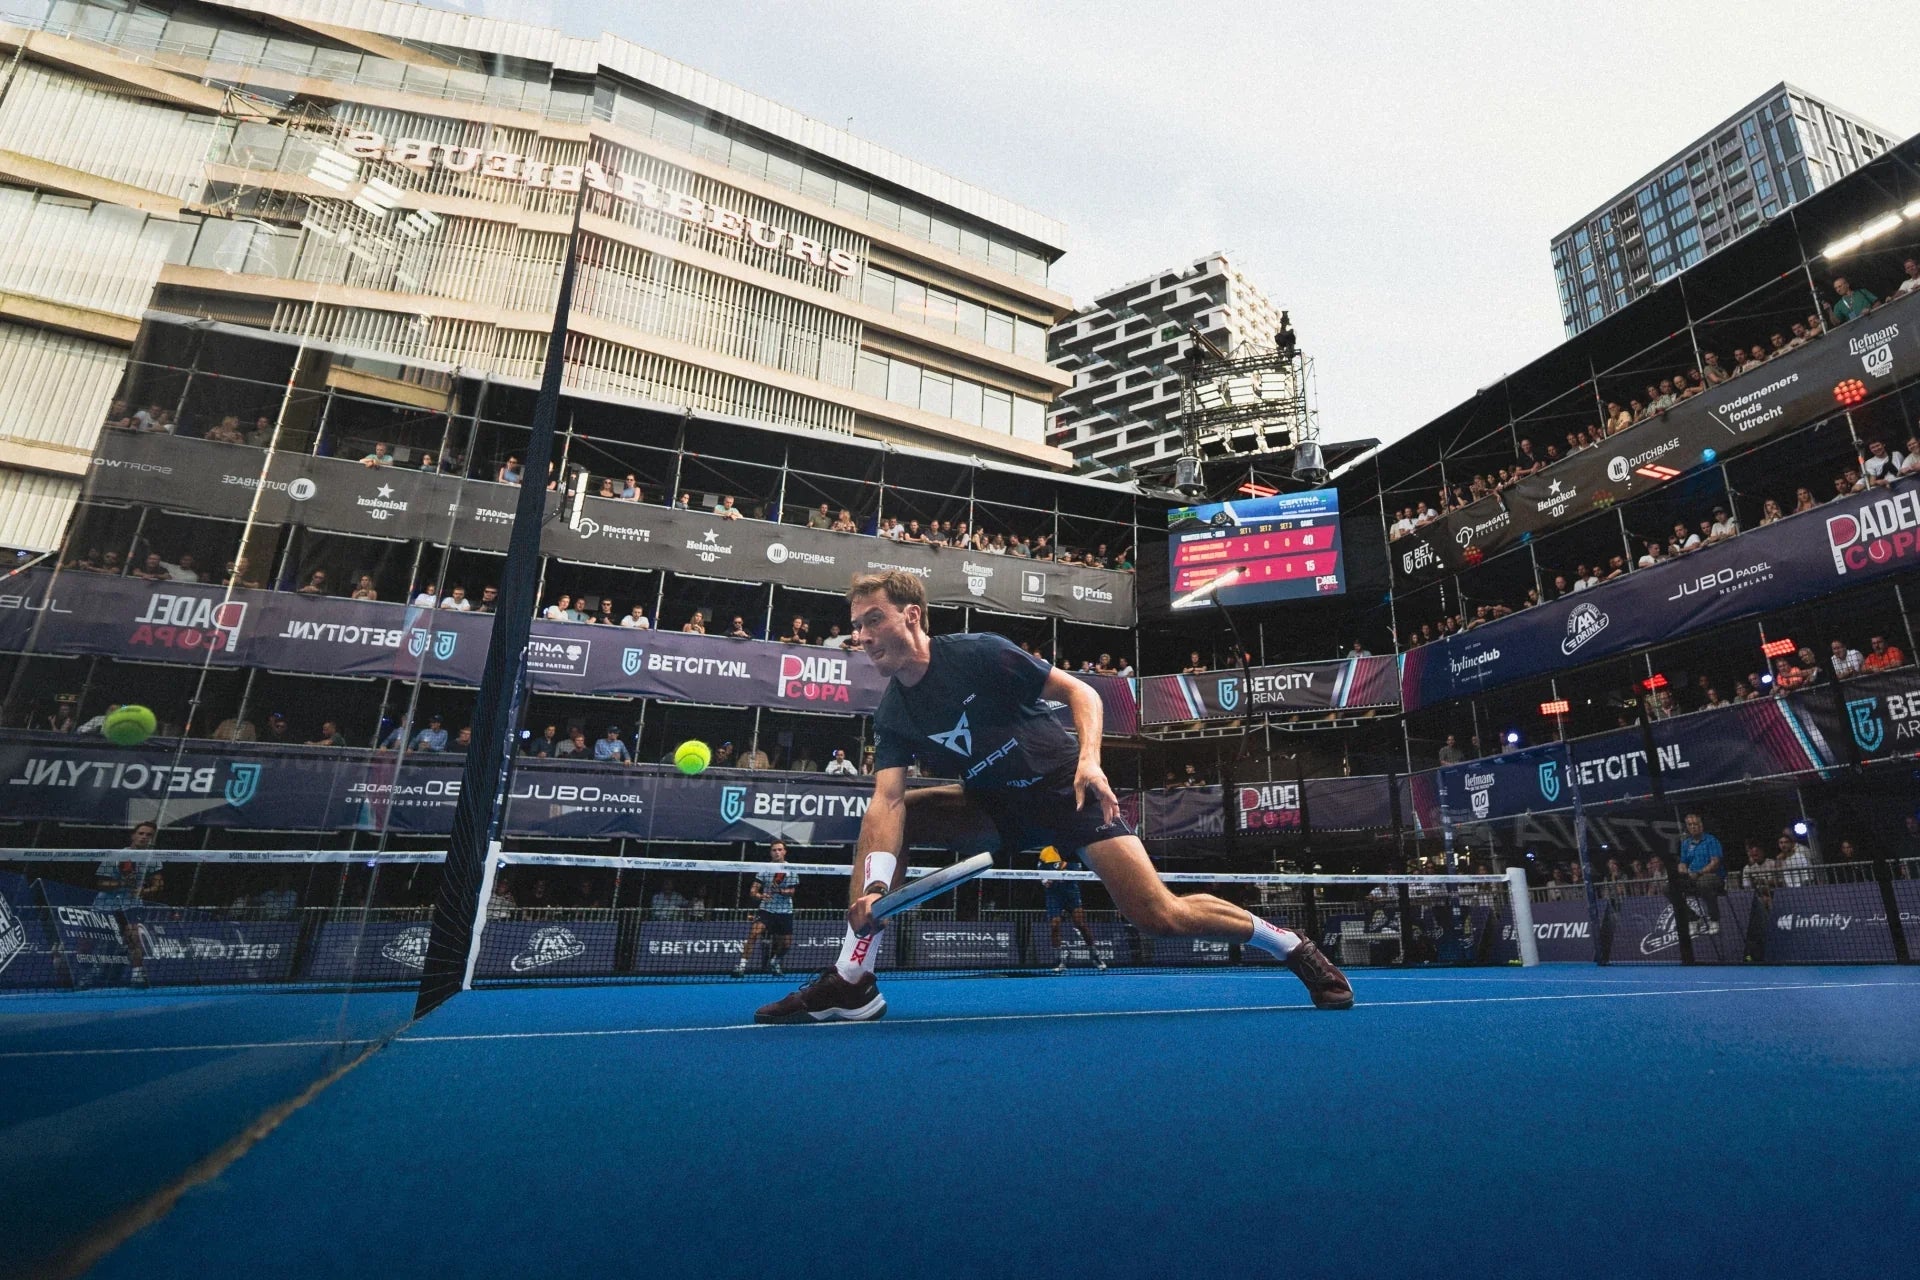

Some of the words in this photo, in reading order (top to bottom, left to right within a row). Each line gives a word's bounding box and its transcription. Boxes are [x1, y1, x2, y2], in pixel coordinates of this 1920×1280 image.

[1849, 323, 1899, 356] Liefmans
[1718, 373, 1799, 415] Ondernemers
[1729, 402, 1763, 423] fonds
[1739, 405, 1784, 431] Utrecht
[1629, 437, 1680, 468] DUTCHBASE
[1537, 488, 1577, 512] Heineken
[602, 524, 650, 538] BlackGATE
[1475, 511, 1510, 532] BlackGATE
[602, 532, 650, 543] TELECOM
[686, 540, 733, 555] Heineken
[1303, 534, 1314, 546] 40
[789, 550, 836, 564] DUTCHBASE
[1414, 543, 1430, 559] BET
[1415, 552, 1433, 570] CITY
[1305, 560, 1316, 572] 15
[1668, 568, 1734, 601] JUBO
[1736, 562, 1771, 580] PADEL
[1719, 573, 1774, 595] NEDERLAND
[1085, 587, 1113, 601] Prins
[1575, 620, 1601, 644] DRINK
[1577, 611, 1595, 634] AA
[648, 653, 750, 678] BETCITY.NL
[777, 654, 851, 698] PADEL
[786, 682, 849, 702] COPA
[508, 784, 600, 801] JUBO
[602, 793, 644, 804] PADEL
[576, 806, 643, 814] NEDERLAND
[57, 906, 111, 932] CERTINA
[1795, 913, 1851, 930] infinity
[922, 931, 994, 941] CERTINA
